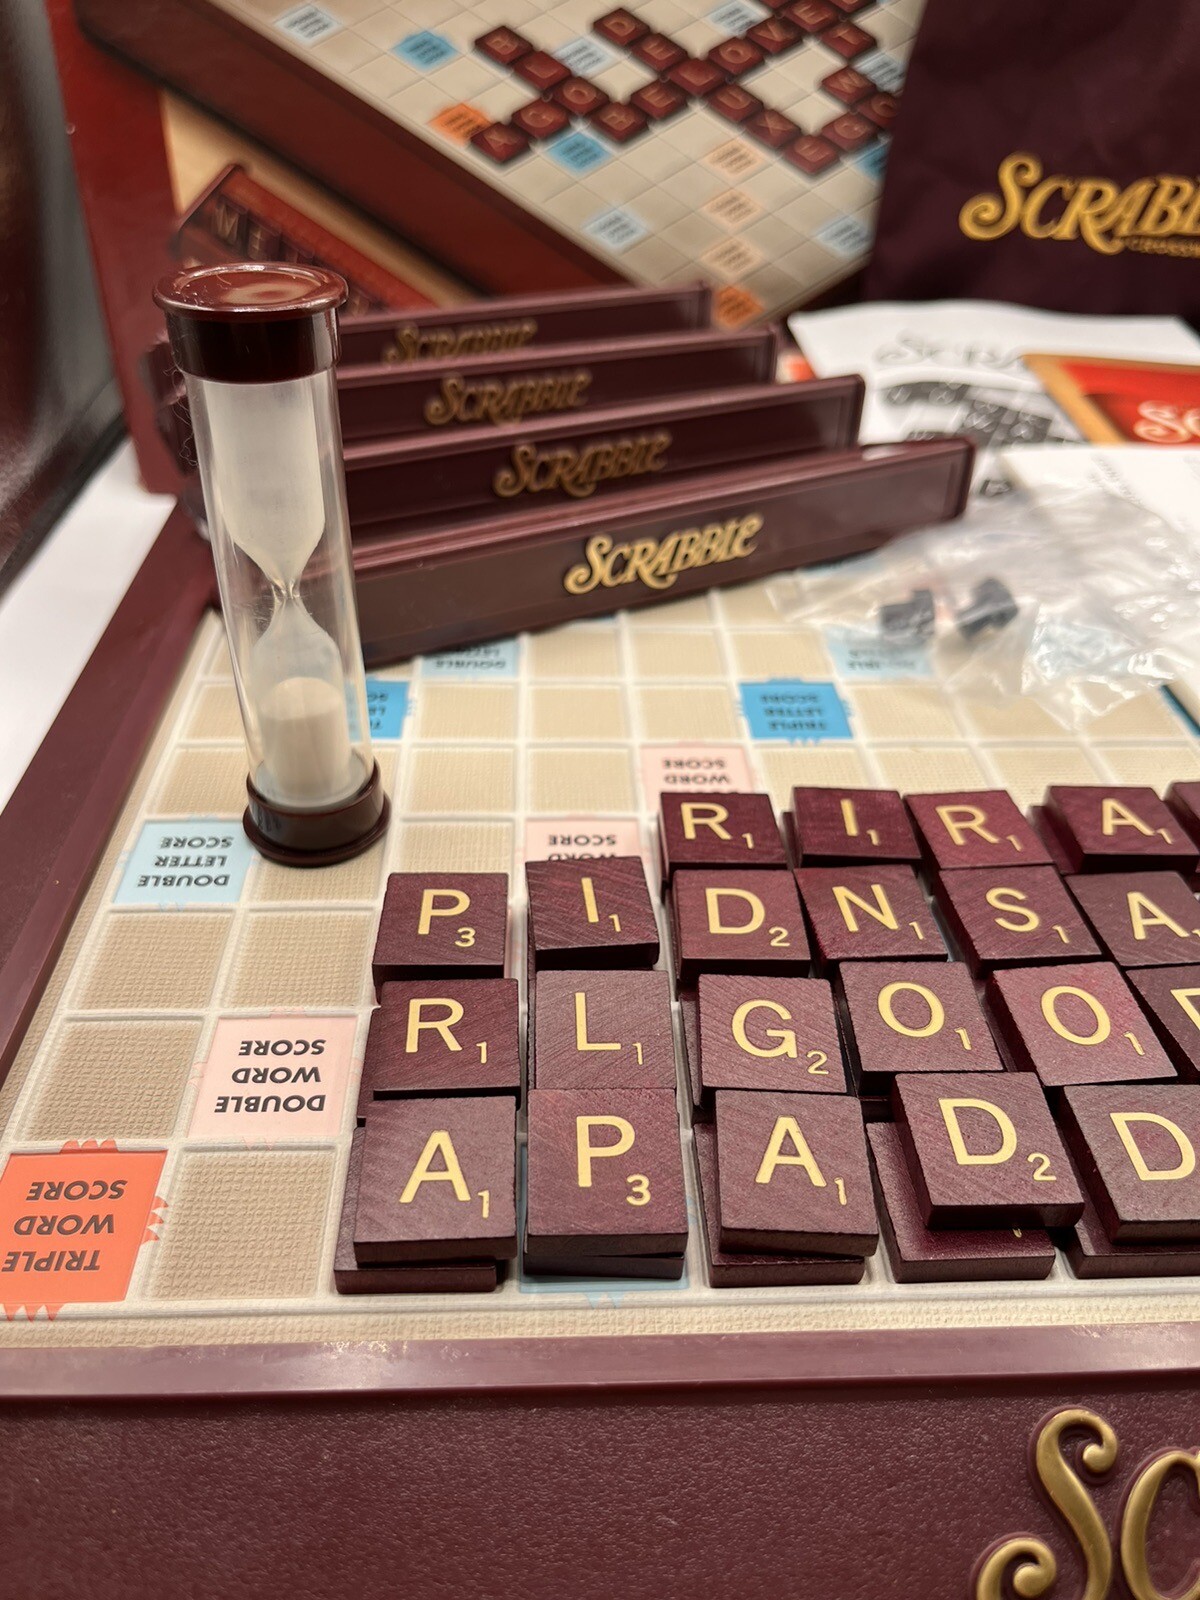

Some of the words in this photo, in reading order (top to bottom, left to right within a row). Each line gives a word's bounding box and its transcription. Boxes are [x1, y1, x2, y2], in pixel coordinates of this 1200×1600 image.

[493, 430, 672, 498] SCRABBLE
[563, 513, 765, 595] SCRABBLE
[662, 758, 727, 770] SCORE
[664, 775, 730, 786] WORD
[160, 835, 235, 849] SCORE
[548, 834, 617, 847] SCORE
[154, 854, 227, 868] LETTER
[137, 873, 231, 888] DOUBLE
[238, 1037, 327, 1056] SCORE
[231, 1065, 323, 1084] WORD
[213, 1095, 327, 1114] DOUBLE
[26, 1179, 128, 1201] SCORE
[13, 1213, 116, 1237] WORD
[1, 1249, 101, 1272] TRIPLE
